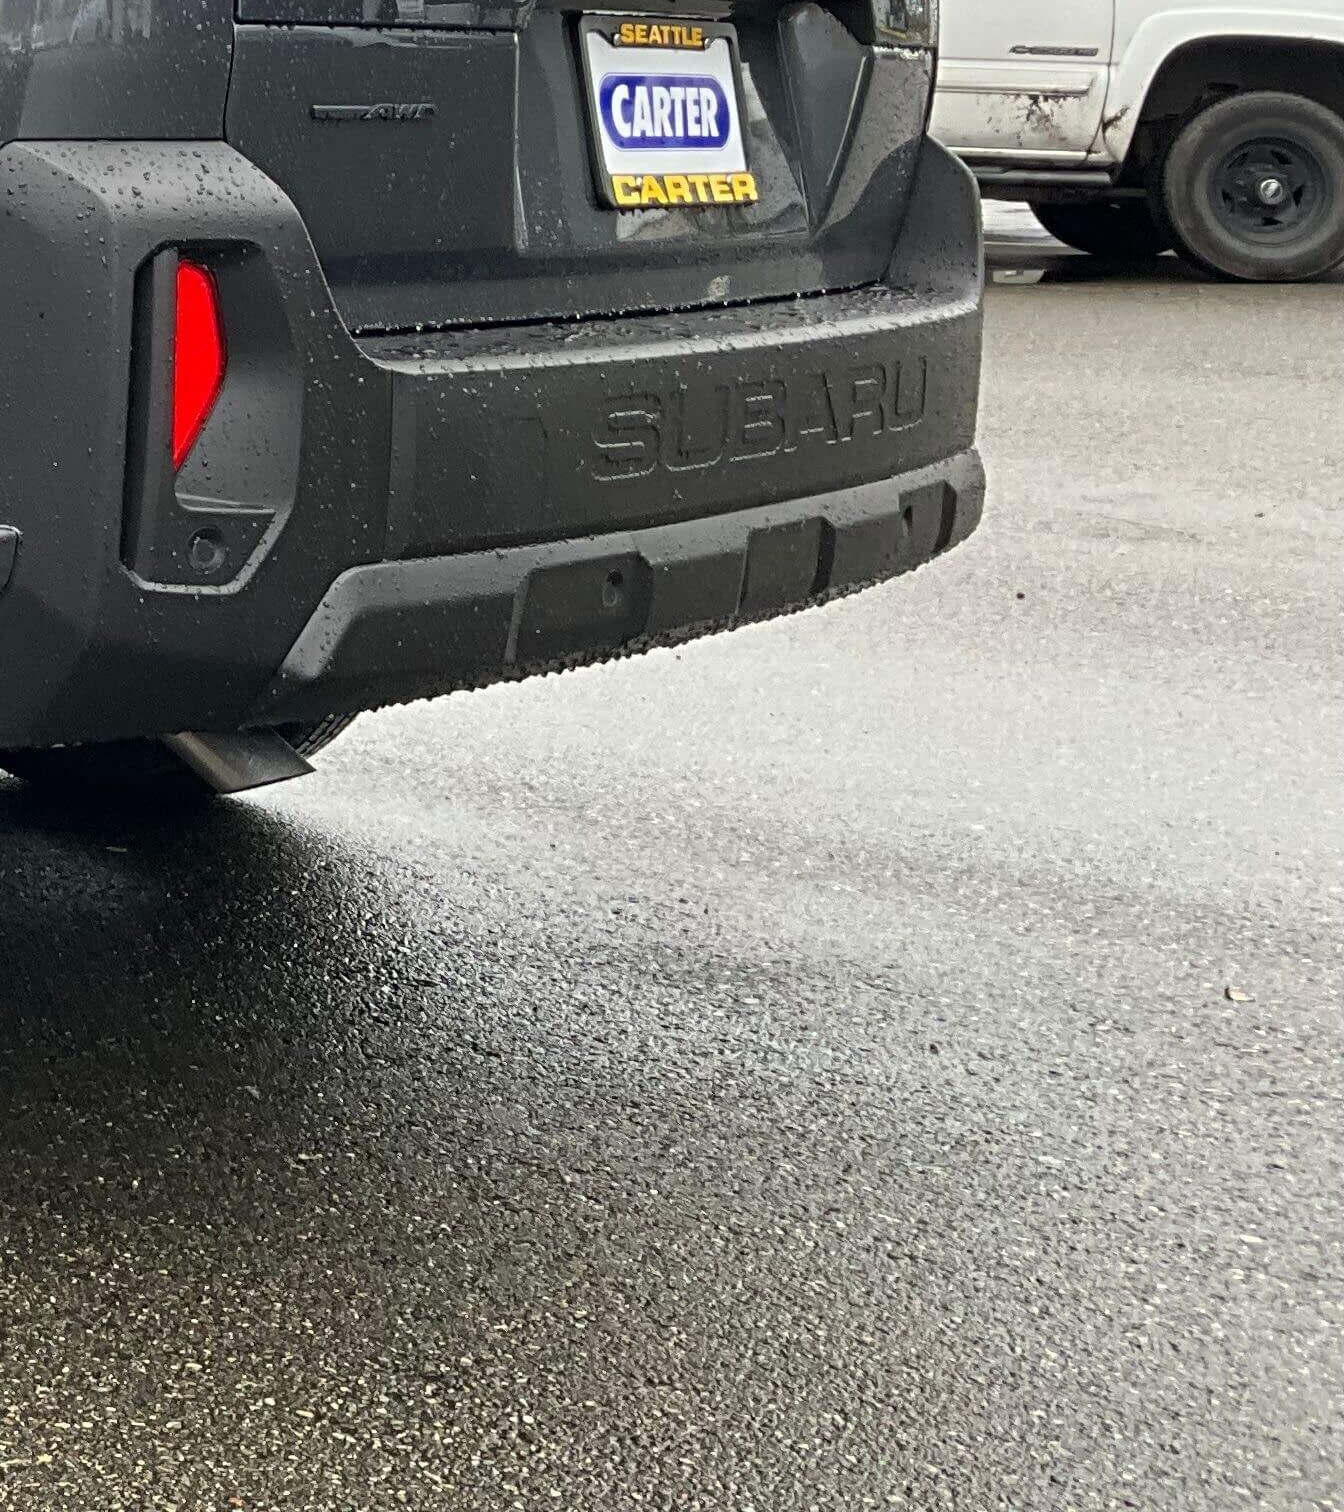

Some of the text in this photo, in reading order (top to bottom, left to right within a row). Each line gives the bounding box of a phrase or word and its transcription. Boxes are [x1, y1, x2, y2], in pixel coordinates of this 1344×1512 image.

[619, 23, 703, 48] SEATTLE
[611, 84, 720, 138] CARTER
[611, 172, 759, 206] CARTER
[591, 355, 928, 482] SUBARU
